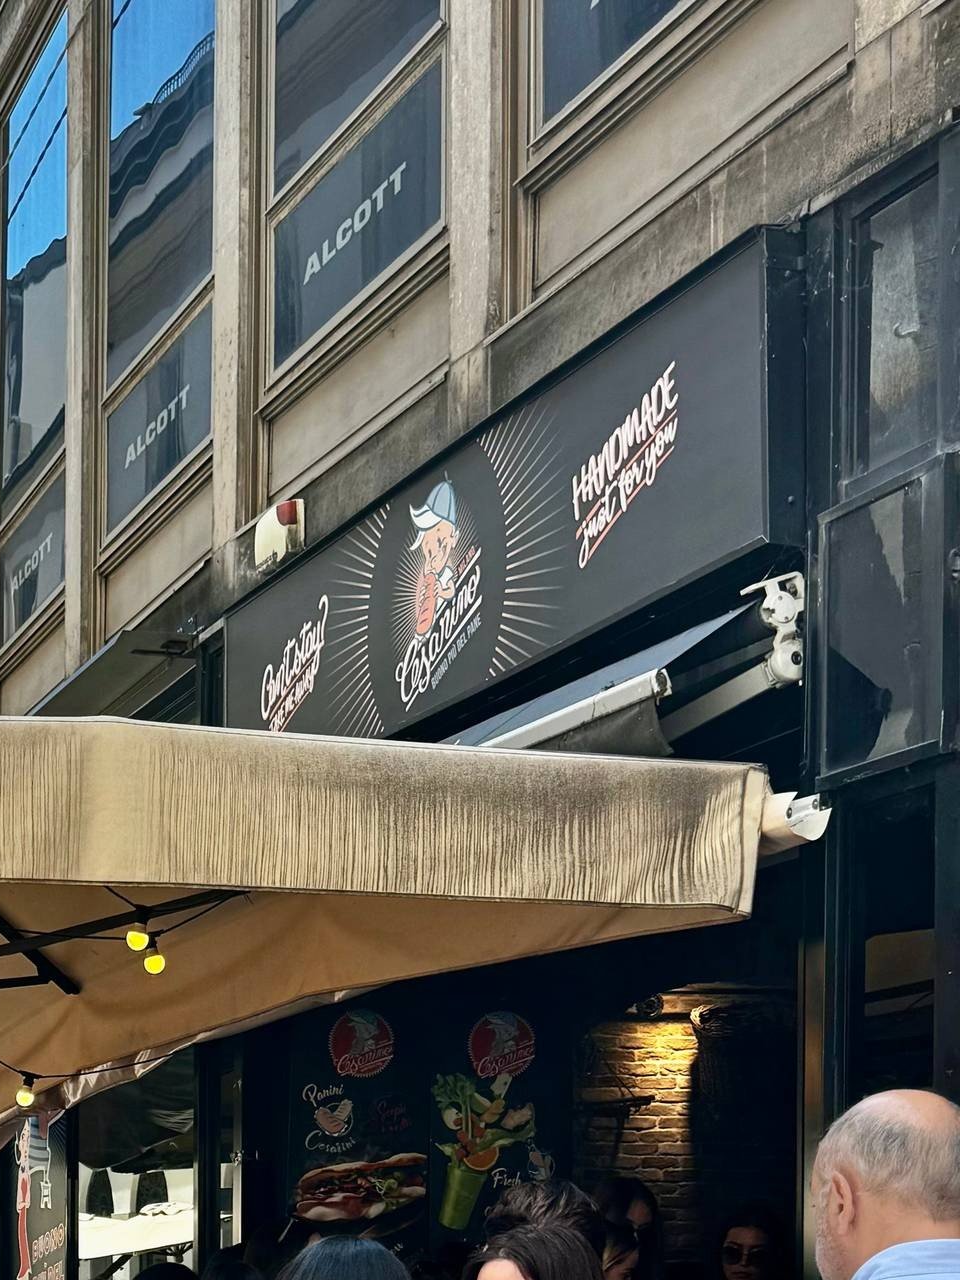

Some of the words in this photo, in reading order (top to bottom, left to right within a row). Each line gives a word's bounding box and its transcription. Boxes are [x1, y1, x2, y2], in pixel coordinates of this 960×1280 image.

[303, 162, 406, 285] ALCOTT
[124, 384, 190, 469] ALCOTT
[572, 361, 678, 520] HANDMADE
[579, 480, 617, 568] just
[618, 460, 644, 512] for
[644, 418, 678, 486] you
[10, 532, 53, 591] ALCOTT
[457, 632, 467, 653] DEL
[467, 612, 481, 641] PANE
[302, 1083, 344, 1107] Panini
[32, 1223, 64, 1264] BUONO
